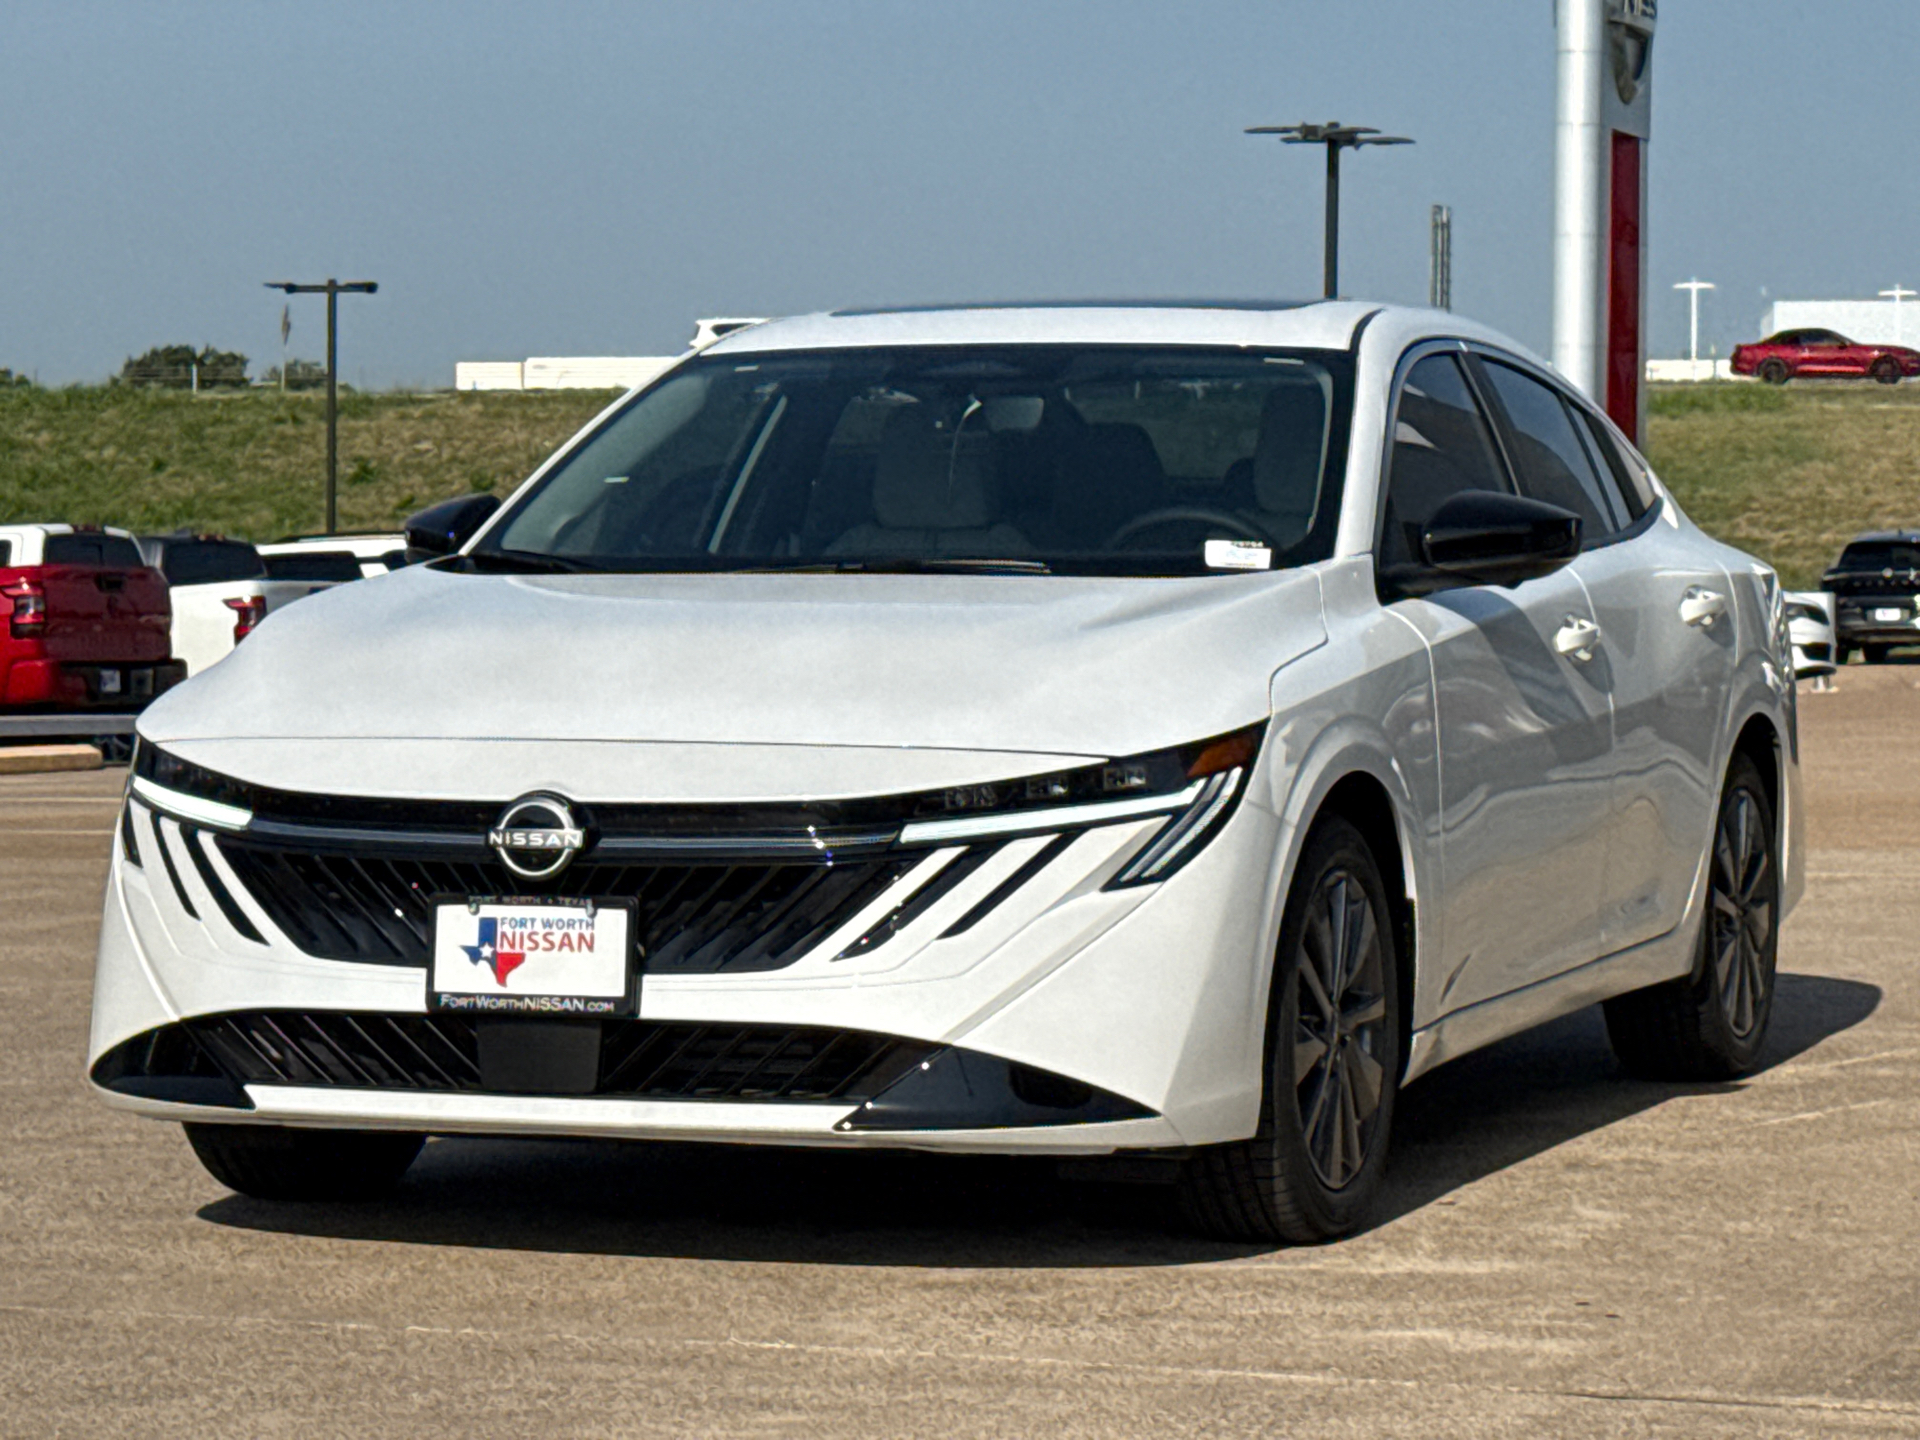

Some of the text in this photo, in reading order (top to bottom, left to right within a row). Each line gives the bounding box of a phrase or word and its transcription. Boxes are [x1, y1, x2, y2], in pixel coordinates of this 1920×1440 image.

[489, 831, 580, 847] NISSAN
[502, 896, 541, 904] WORTH
[499, 917, 595, 931] FORT WORTH
[499, 931, 595, 953] NISSAN
